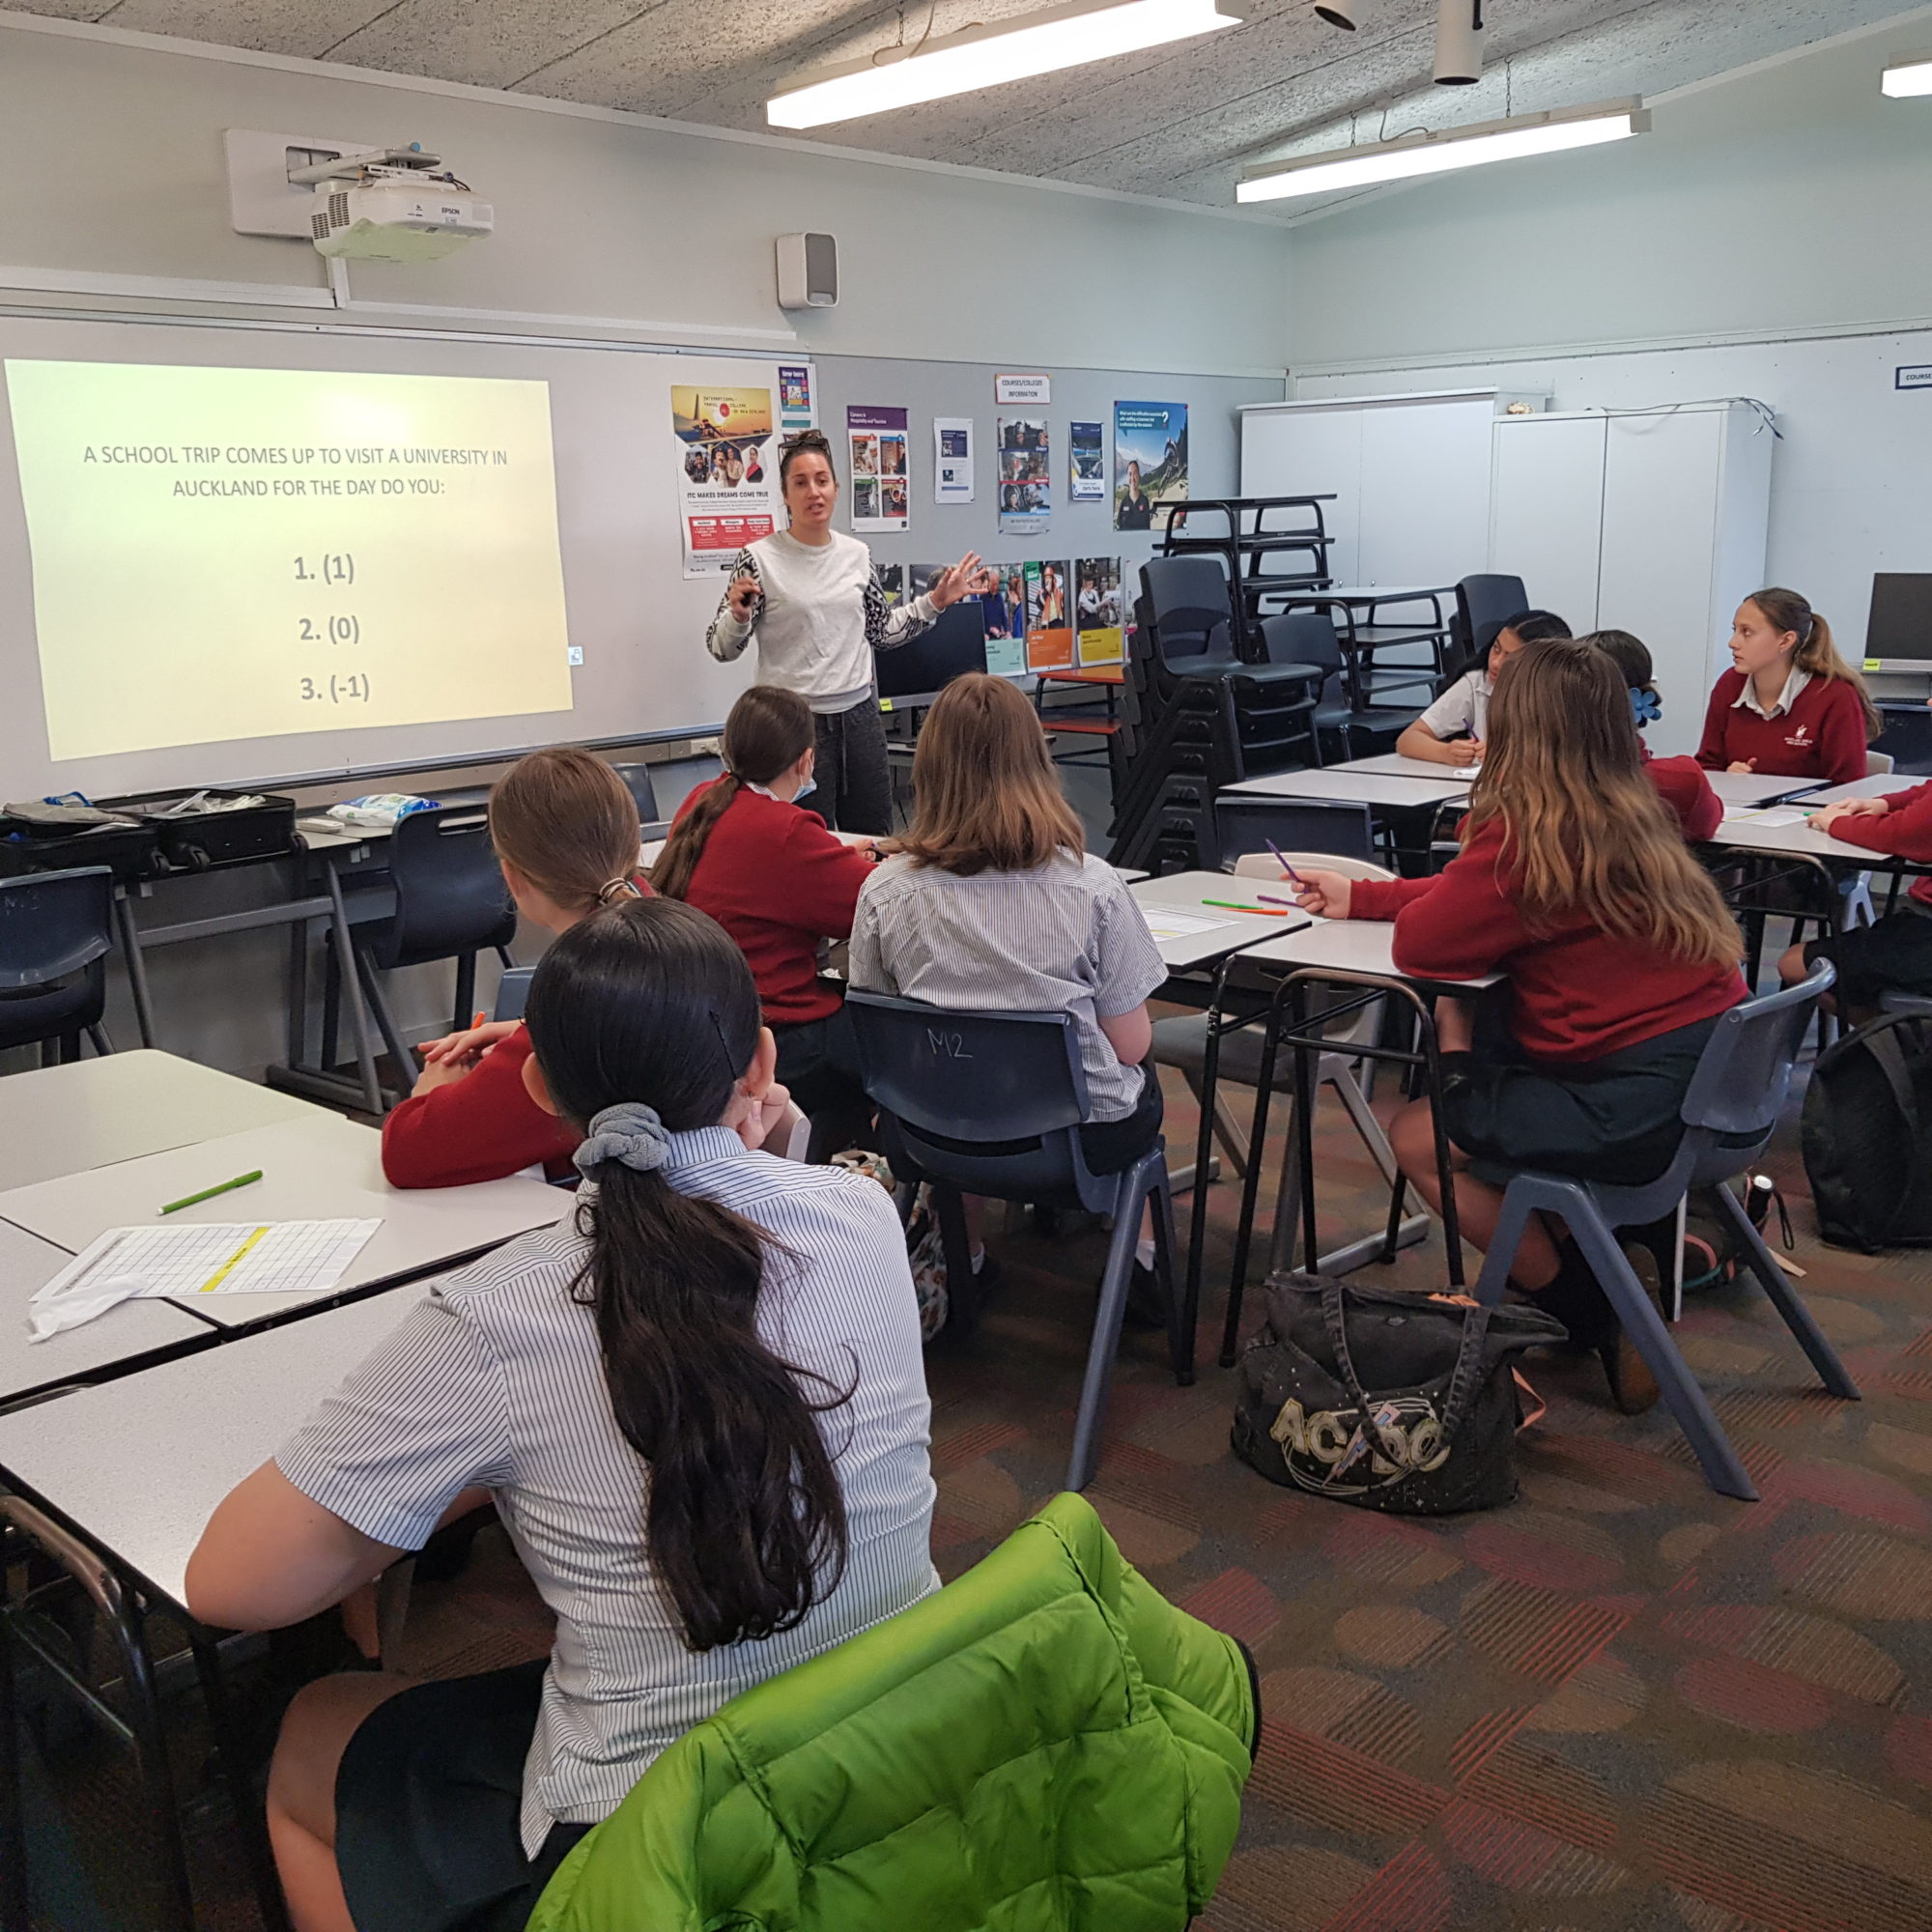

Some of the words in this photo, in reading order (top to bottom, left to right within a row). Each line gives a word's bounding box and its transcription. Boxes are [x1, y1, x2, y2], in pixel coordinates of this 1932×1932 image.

[83, 446, 98, 464] A
[101, 446, 179, 464] SCHOOL
[182, 447, 220, 464] TRIP
[226, 447, 288, 464] COMES
[292, 448, 315, 464] UP
[319, 448, 341, 464] TO
[345, 448, 384, 464] VISIT
[388, 448, 400, 464] A
[404, 448, 489, 465] UNIVERSITY
[493, 450, 507, 465] IN
[173, 479, 268, 497] AUCKLAND
[273, 479, 306, 497] FOR
[309, 479, 342, 496] THE
[347, 479, 376, 496] DAY
[382, 479, 405, 496] DO
[408, 478, 445, 495] YOU:
[294, 556, 316, 580] 1.
[324, 554, 355, 585] (1)
[299, 617, 322, 640] 2.
[328, 614, 359, 645] (0)
[300, 677, 323, 700] 3.
[330, 673, 369, 703] (-1)
[926, 1027, 974, 1059] M2
